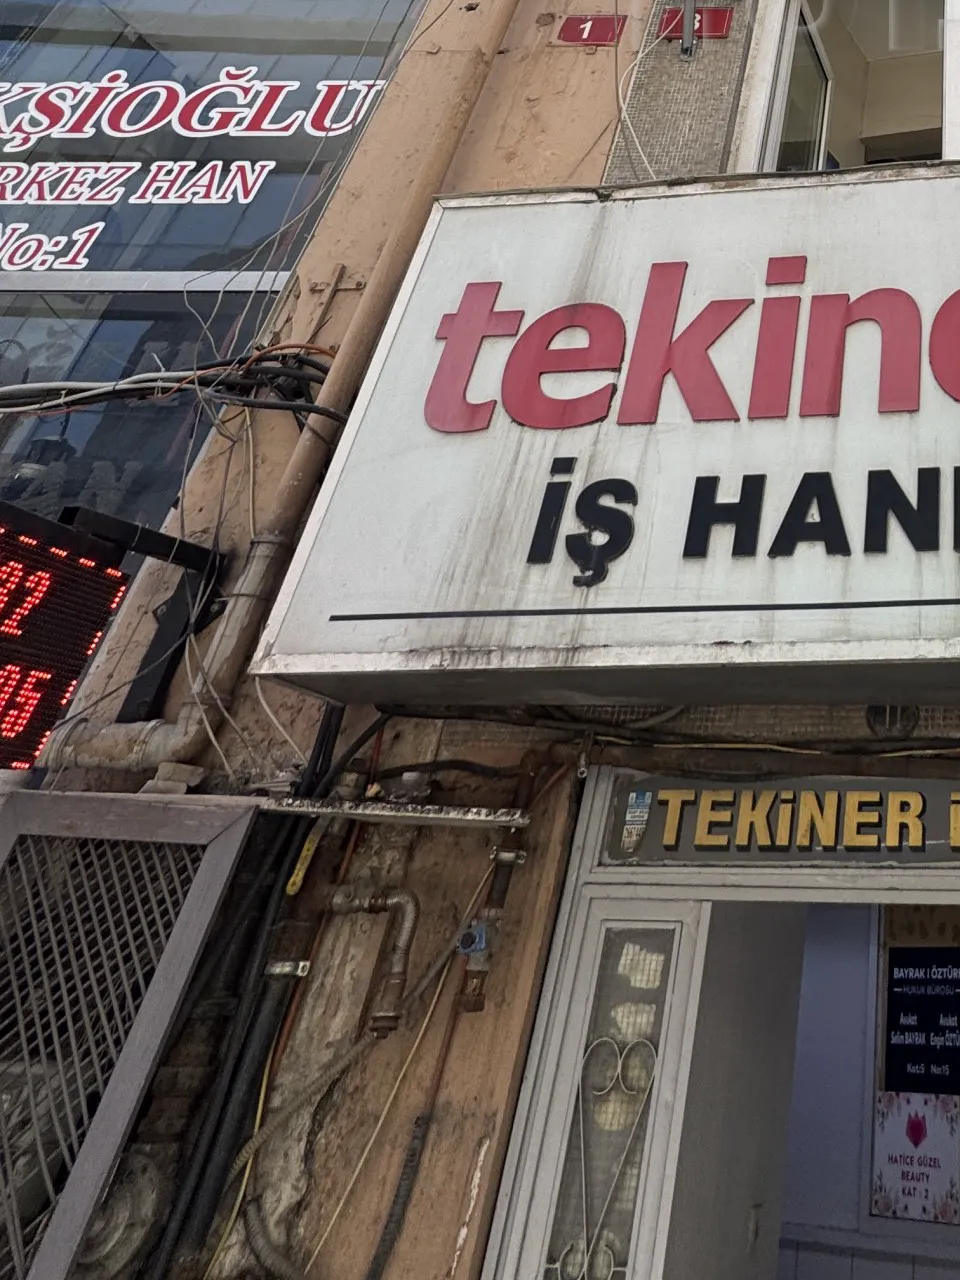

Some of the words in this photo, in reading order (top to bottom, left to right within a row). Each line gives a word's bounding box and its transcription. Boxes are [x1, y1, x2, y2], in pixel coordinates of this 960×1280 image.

[579, 20, 593, 39] 1
[128, 159, 277, 205] HAN
[893, 967, 926, 980] BAYRAK
[901, 1170, 931, 1183] BEAUTY
